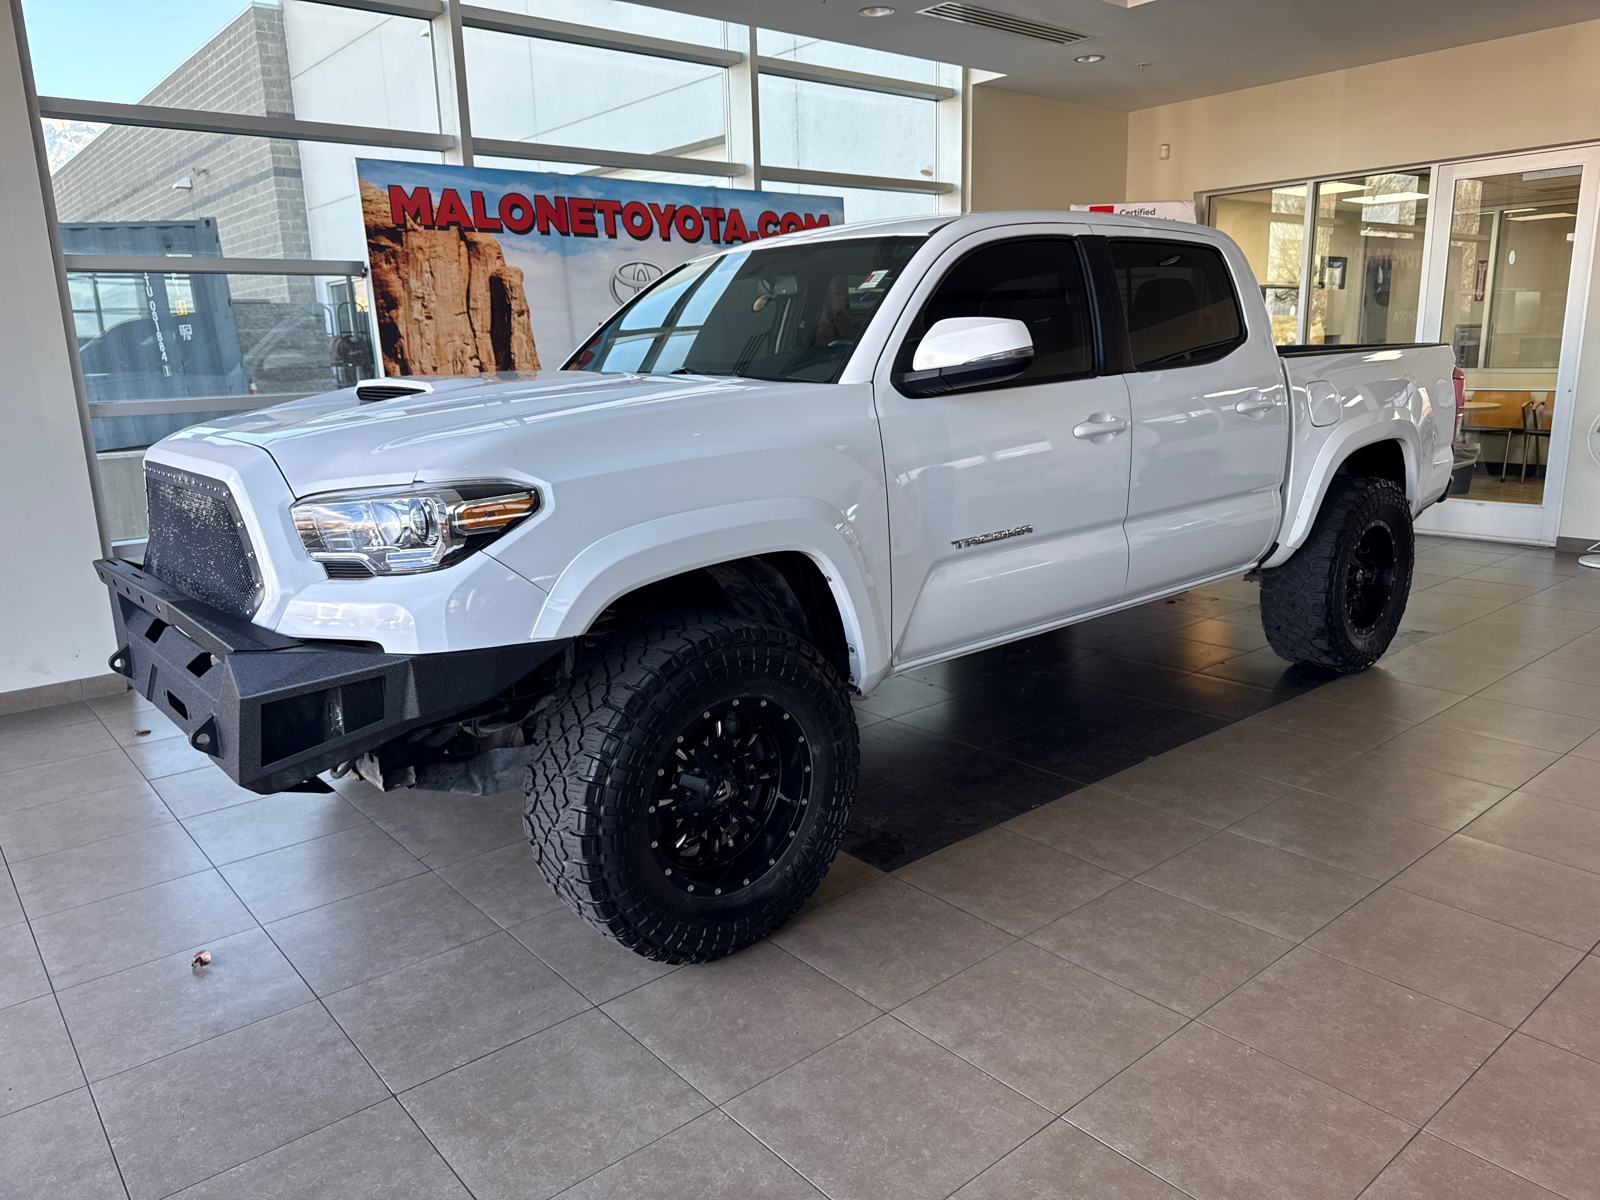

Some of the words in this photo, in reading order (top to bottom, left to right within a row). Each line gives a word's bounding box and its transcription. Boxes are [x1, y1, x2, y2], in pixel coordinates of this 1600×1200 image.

[1120, 207, 1156, 216] Certified
[951, 524, 1034, 549] TACOMA
[781, 804, 828, 882] KENDA
